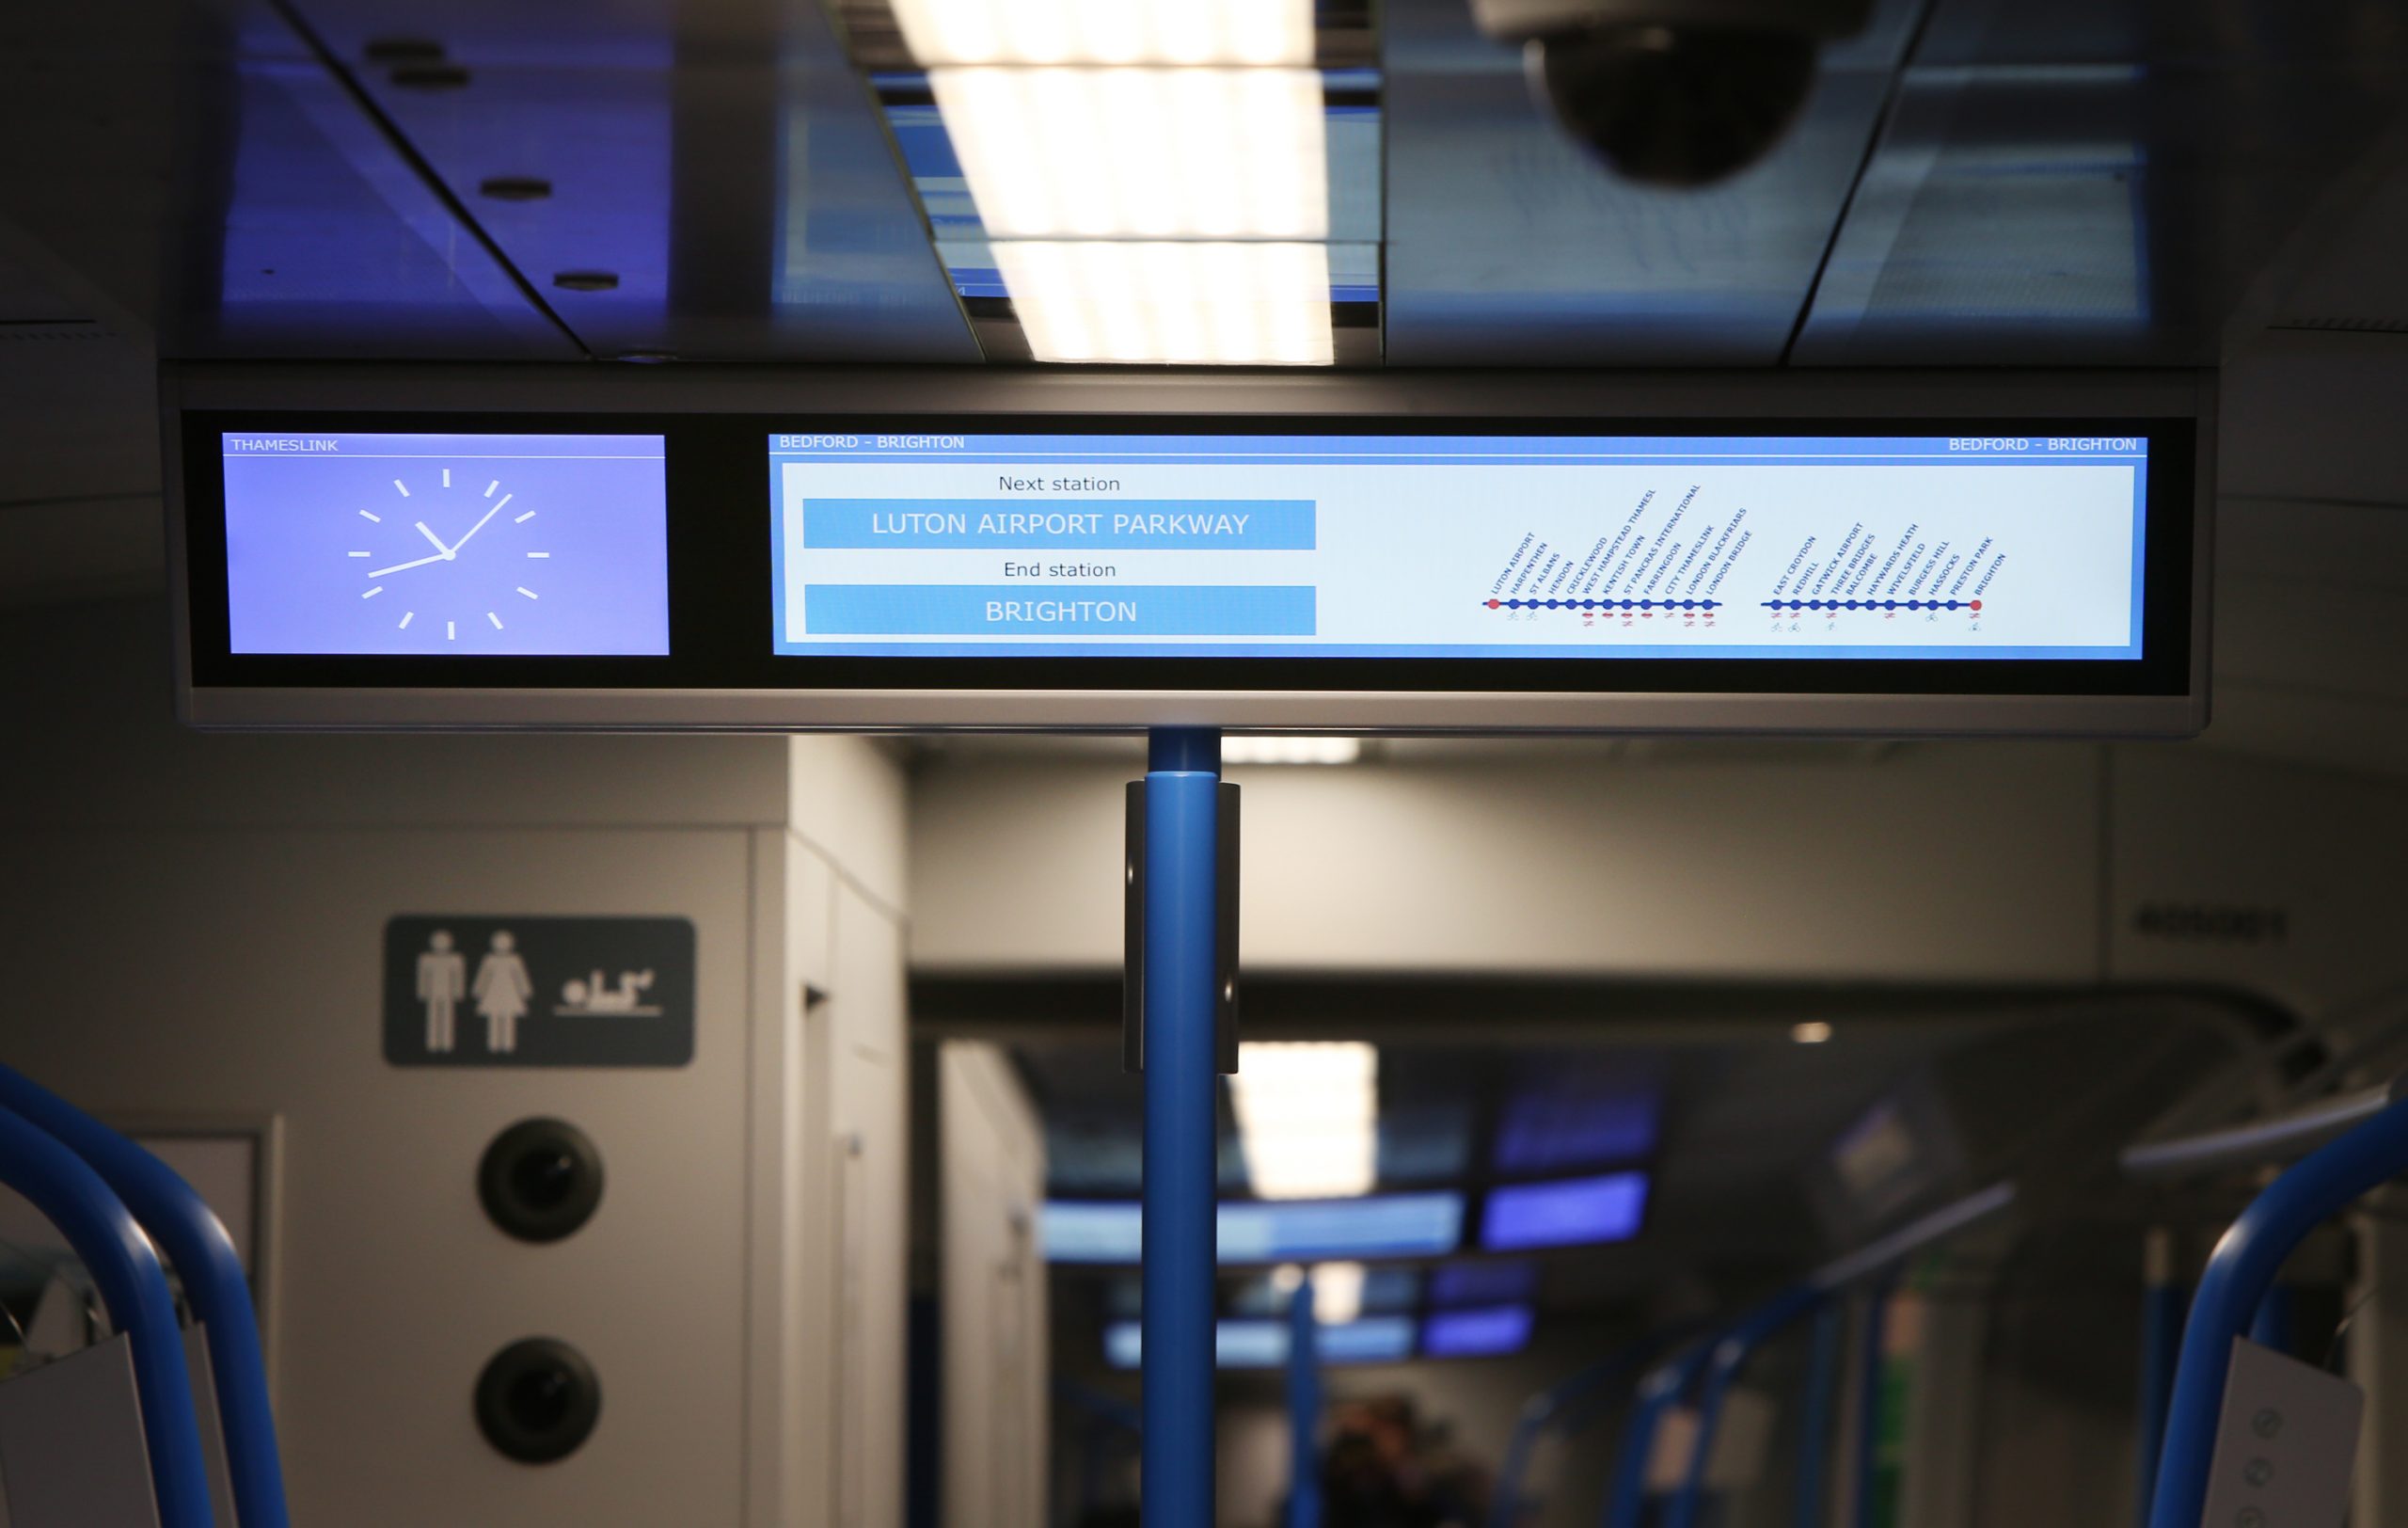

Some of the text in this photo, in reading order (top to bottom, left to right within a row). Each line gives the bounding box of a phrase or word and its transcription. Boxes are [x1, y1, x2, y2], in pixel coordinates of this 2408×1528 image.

[230, 438, 339, 452] THAMESLINK
[779, 436, 859, 449] BEDFORD
[877, 436, 965, 449] BRIGHTON
[1948, 438, 2029, 451] BEDFORD
[2047, 438, 2137, 451] BRIGHTON
[999, 475, 1120, 491] Next station
[872, 512, 1250, 535] LUTON AIRPORT PARKWAY
[1581, 489, 1656, 595] WEST HAMPSTEAD THAMESL
[1623, 485, 1702, 596] ST PANCRAS INTERNATIONAL
[1005, 562, 1116, 578] End station
[1490, 532, 1535, 595] LUTON AIRPORT
[1529, 552, 1560, 596] ST ALBANS
[1547, 560, 1575, 596] HENDON
[1565, 536, 1608, 595] CRICKLEWOOD
[1602, 534, 1646, 596] KENTISH TOWN
[1642, 542, 1682, 596] FARRINGDON
[1664, 524, 1715, 596] CITY THAMESLINK
[1685, 507, 1748, 596] LONDON BLACKFRIARS
[1704, 530, 1753, 596] LONDON BRIDGE
[1772, 535, 1817, 596] EAST CROYDON
[1811, 521, 1863, 596] GATWICK AIRPORT
[1830, 533, 1876, 595] THREE BRIDGES
[1845, 552, 1878, 597] BALCOMBE
[1866, 523, 1919, 597] HAYWARDS HEATH
[1886, 542, 1926, 596] WIVELSFIELD
[1907, 541, 1950, 597] BURGESS HILL
[1927, 553, 1960, 597] HASSOCKS
[1948, 535, 1994, 597] PRESTON PARK
[1972, 552, 2006, 597] BRIGHTON
[1791, 562, 1820, 596] REDHILL
[986, 600, 1136, 622] BRIGHTON
